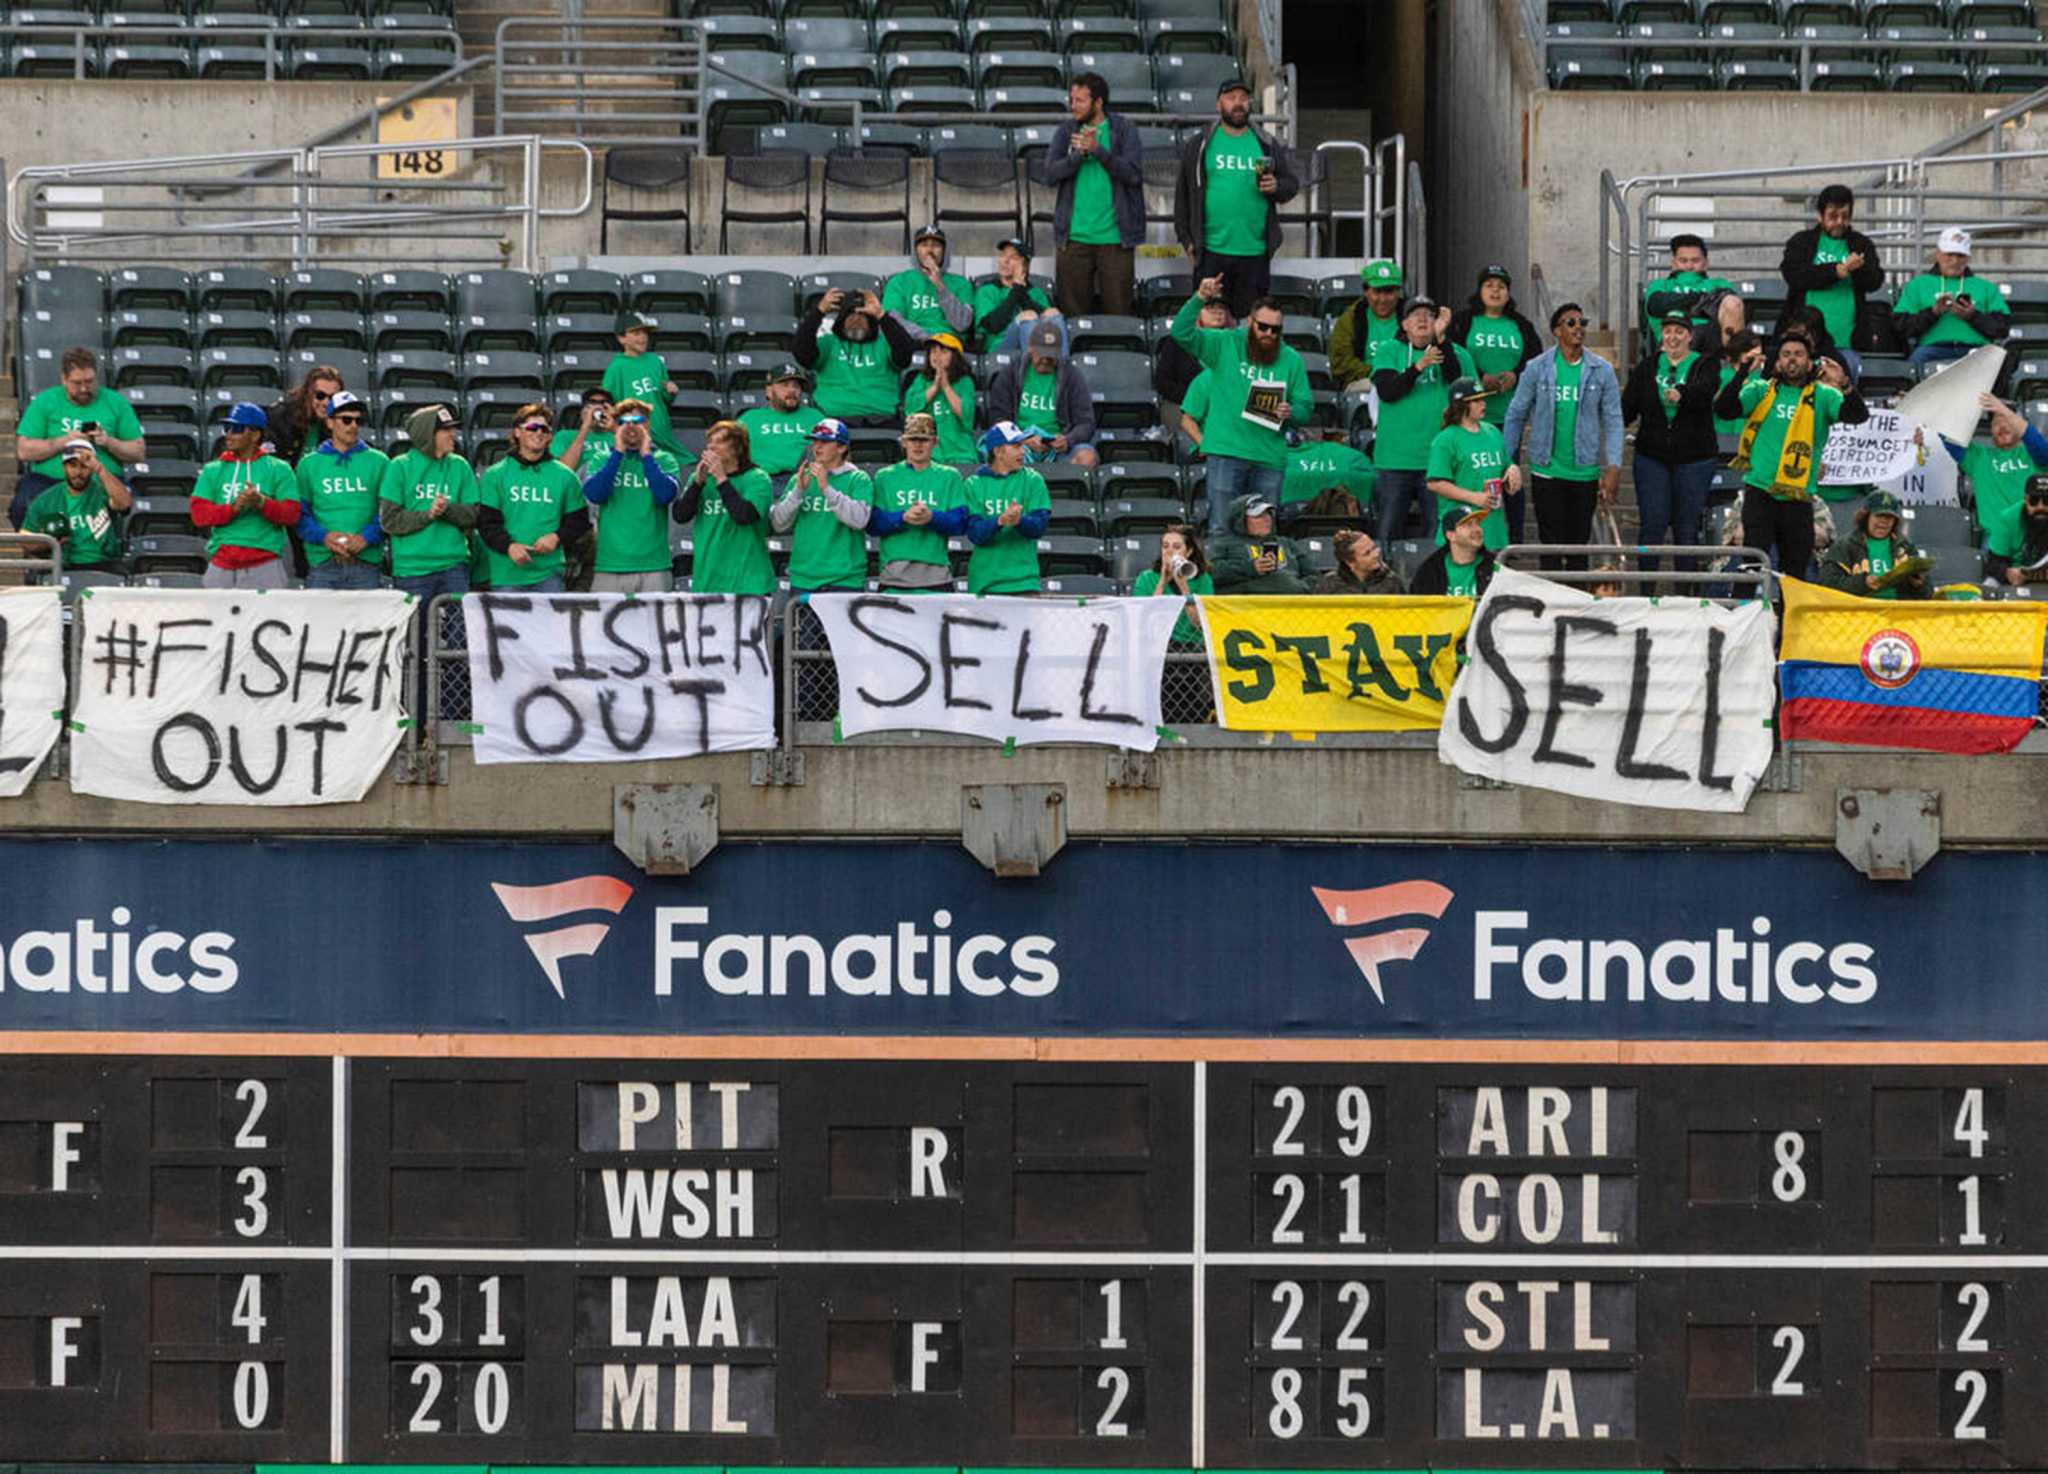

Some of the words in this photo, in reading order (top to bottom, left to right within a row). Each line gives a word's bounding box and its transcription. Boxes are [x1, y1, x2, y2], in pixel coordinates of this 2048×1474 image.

[394, 149, 444, 174] 148
[1216, 154, 1258, 171] SELL
[912, 294, 940, 310] SEL
[1475, 332, 1520, 350] SELL
[631, 376, 659, 396] SE
[1020, 391, 1057, 411] SELL
[1555, 384, 1579, 401] SEL
[1776, 403, 1797, 420] SE
[761, 422, 806, 435] SELL
[1869, 414, 1900, 432] THE
[321, 477, 368, 494] SELL
[415, 483, 452, 499] SELL
[509, 485, 554, 502] SELL
[802, 496, 836, 512] SEL
[896, 489, 938, 506] SELL
[1825, 463, 1846, 478] HE
[1903, 474, 1925, 494] IN
[703, 499, 729, 515] SE
[984, 499, 1023, 516] SEL
[480, 594, 769, 682] FISHER
[848, 595, 1144, 726] SELL
[1222, 622, 1453, 704] STAY
[514, 683, 726, 755] OUT
[1458, 594, 1758, 792] SELL
[152, 711, 347, 795] OUT
[0, 906, 239, 993] atics
[654, 906, 1060, 997] Fanatics
[1473, 910, 1878, 1004] Fanatics
[234, 1079, 269, 1149] 2
[617, 1081, 751, 1151] PIT
[1467, 1087, 1609, 1157] ARI
[1953, 1088, 1989, 1158] 4
[52, 1122, 84, 1192] F
[910, 1127, 949, 1197] R
[1771, 1131, 1807, 1202] 8
[233, 1166, 269, 1237] 3
[601, 1168, 754, 1239] WSH
[1458, 1173, 1620, 1245] COL
[1957, 1176, 1988, 1245] 1
[231, 1274, 267, 1344] 4
[610, 1276, 740, 1347] LAA
[1099, 1279, 1128, 1349] 1
[1463, 1281, 1611, 1352] STL
[1956, 1283, 1990, 1352] 2
[50, 1317, 82, 1387] F
[910, 1322, 943, 1392] F
[1771, 1326, 1805, 1396] 2
[233, 1361, 269, 1430] 0
[601, 1364, 748, 1433] MIL
[1096, 1367, 1130, 1437] 2
[1464, 1368, 1610, 1439] L.A.
[1953, 1370, 1988, 1439] 2
